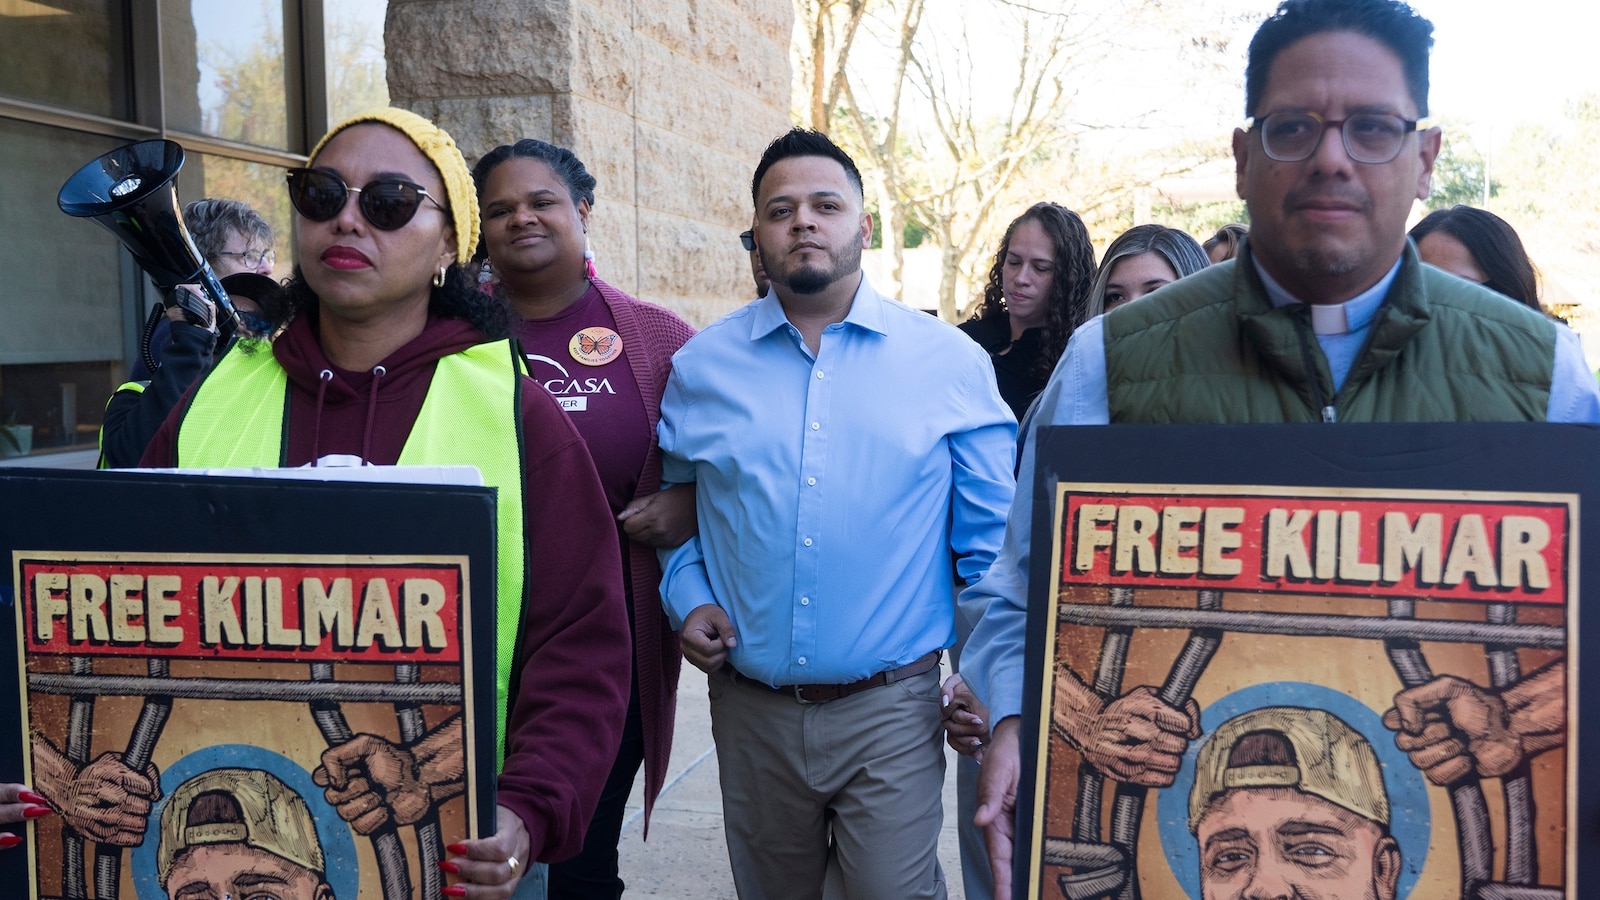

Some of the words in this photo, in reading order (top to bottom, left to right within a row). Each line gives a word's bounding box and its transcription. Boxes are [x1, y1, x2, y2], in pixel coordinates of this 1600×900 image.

[543, 378, 616, 394] CASA
[1073, 503, 1245, 576] FREE
[1262, 507, 1552, 590] KILMAR
[32, 572, 184, 645] FREE
[200, 575, 448, 649] KILMAR
